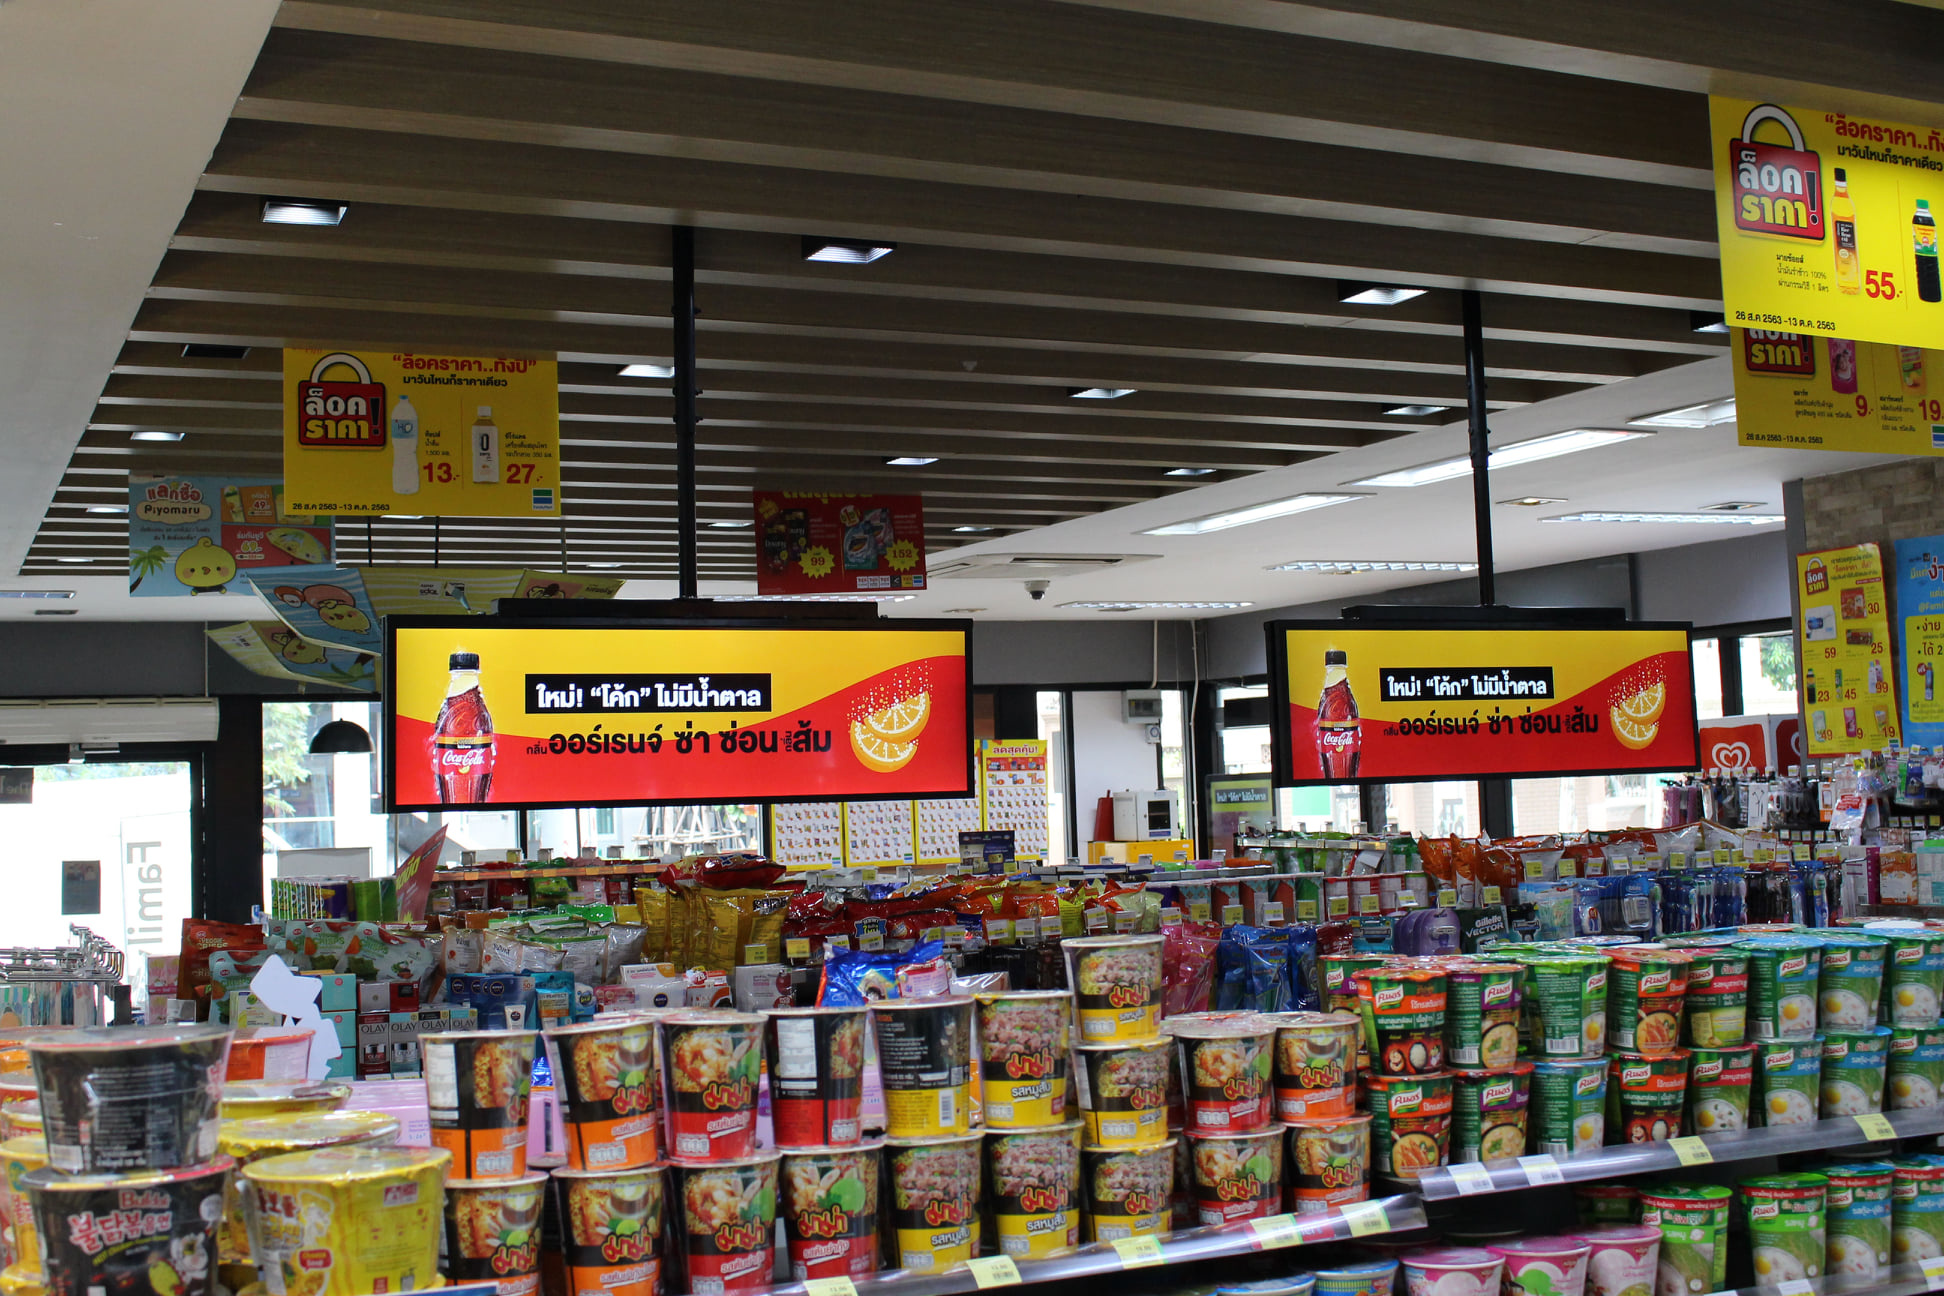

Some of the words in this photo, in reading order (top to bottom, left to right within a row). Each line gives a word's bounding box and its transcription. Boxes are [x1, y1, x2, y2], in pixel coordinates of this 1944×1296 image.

[1738, 150, 1803, 195] ล็อค
[1741, 193, 1808, 229] ราคา
[1810, 271, 1827, 280] 100%
[1736, 311, 1746, 320] 26
[1762, 314, 1782, 325] 2563
[1817, 320, 1836, 331] 2563
[1751, 343, 1802, 366] ราคา
[304, 387, 368, 416] ล็อค
[304, 419, 369, 440] ราคา
[144, 504, 200, 515] Piyomaru
[292, 502, 302, 511] 26
[319, 503, 337, 511] 2563
[371, 503, 390, 512] 2563
[536, 682, 583, 709] ใหม่!
[590, 683, 651, 709] “โค้ก”
[655, 677, 761, 708] ไม่มีน้ำตาล
[1387, 675, 1421, 697] ใหม่!
[1426, 675, 1469, 697] “โค้ก”
[1472, 669, 1547, 696] ไม่มีน้ำตาล
[1399, 709, 1479, 736] ออร์เรนจ์
[1487, 708, 1514, 735] ซ่า
[1518, 707, 1562, 734] ซ่อน
[1571, 705, 1599, 733] ส้ม
[526, 740, 548, 756] กลิ่น
[548, 722, 664, 755] ออร์เรนจ์
[675, 722, 710, 755] ซ่า
[718, 721, 778, 754] ซ่อน
[793, 720, 832, 753] ส้ม
[1324, 730, 1354, 746] Coca-Cola
[442, 748, 485, 768] Coca-Cola
[1465, 922, 1504, 938] VECTOR
[1475, 915, 1502, 928] Gillette
[1109, 982, 1149, 1007] มาม่า
[361, 1024, 388, 1034] OLAY
[391, 1023, 417, 1033] OLAY
[421, 1020, 449, 1030] OLAY
[453, 1020, 476, 1030] OLAY
[1006, 1049, 1054, 1078] มาม่า
[1301, 1063, 1341, 1088] มาม่า
[703, 1077, 750, 1111] มาม่า
[1223, 1072, 1262, 1099] มาม่า
[1217, 1174, 1259, 1200] มาม่า
[1322, 1161, 1360, 1187] มาม่า
[925, 1192, 971, 1225] มาม่า
[1020, 1181, 1068, 1212] มาม่า
[68, 1210, 172, 1255] 불닭볶음면
[715, 1216, 765, 1250] มาม่า
[799, 1206, 847, 1238] มาม่า
[601, 1227, 651, 1262] มาม่า
